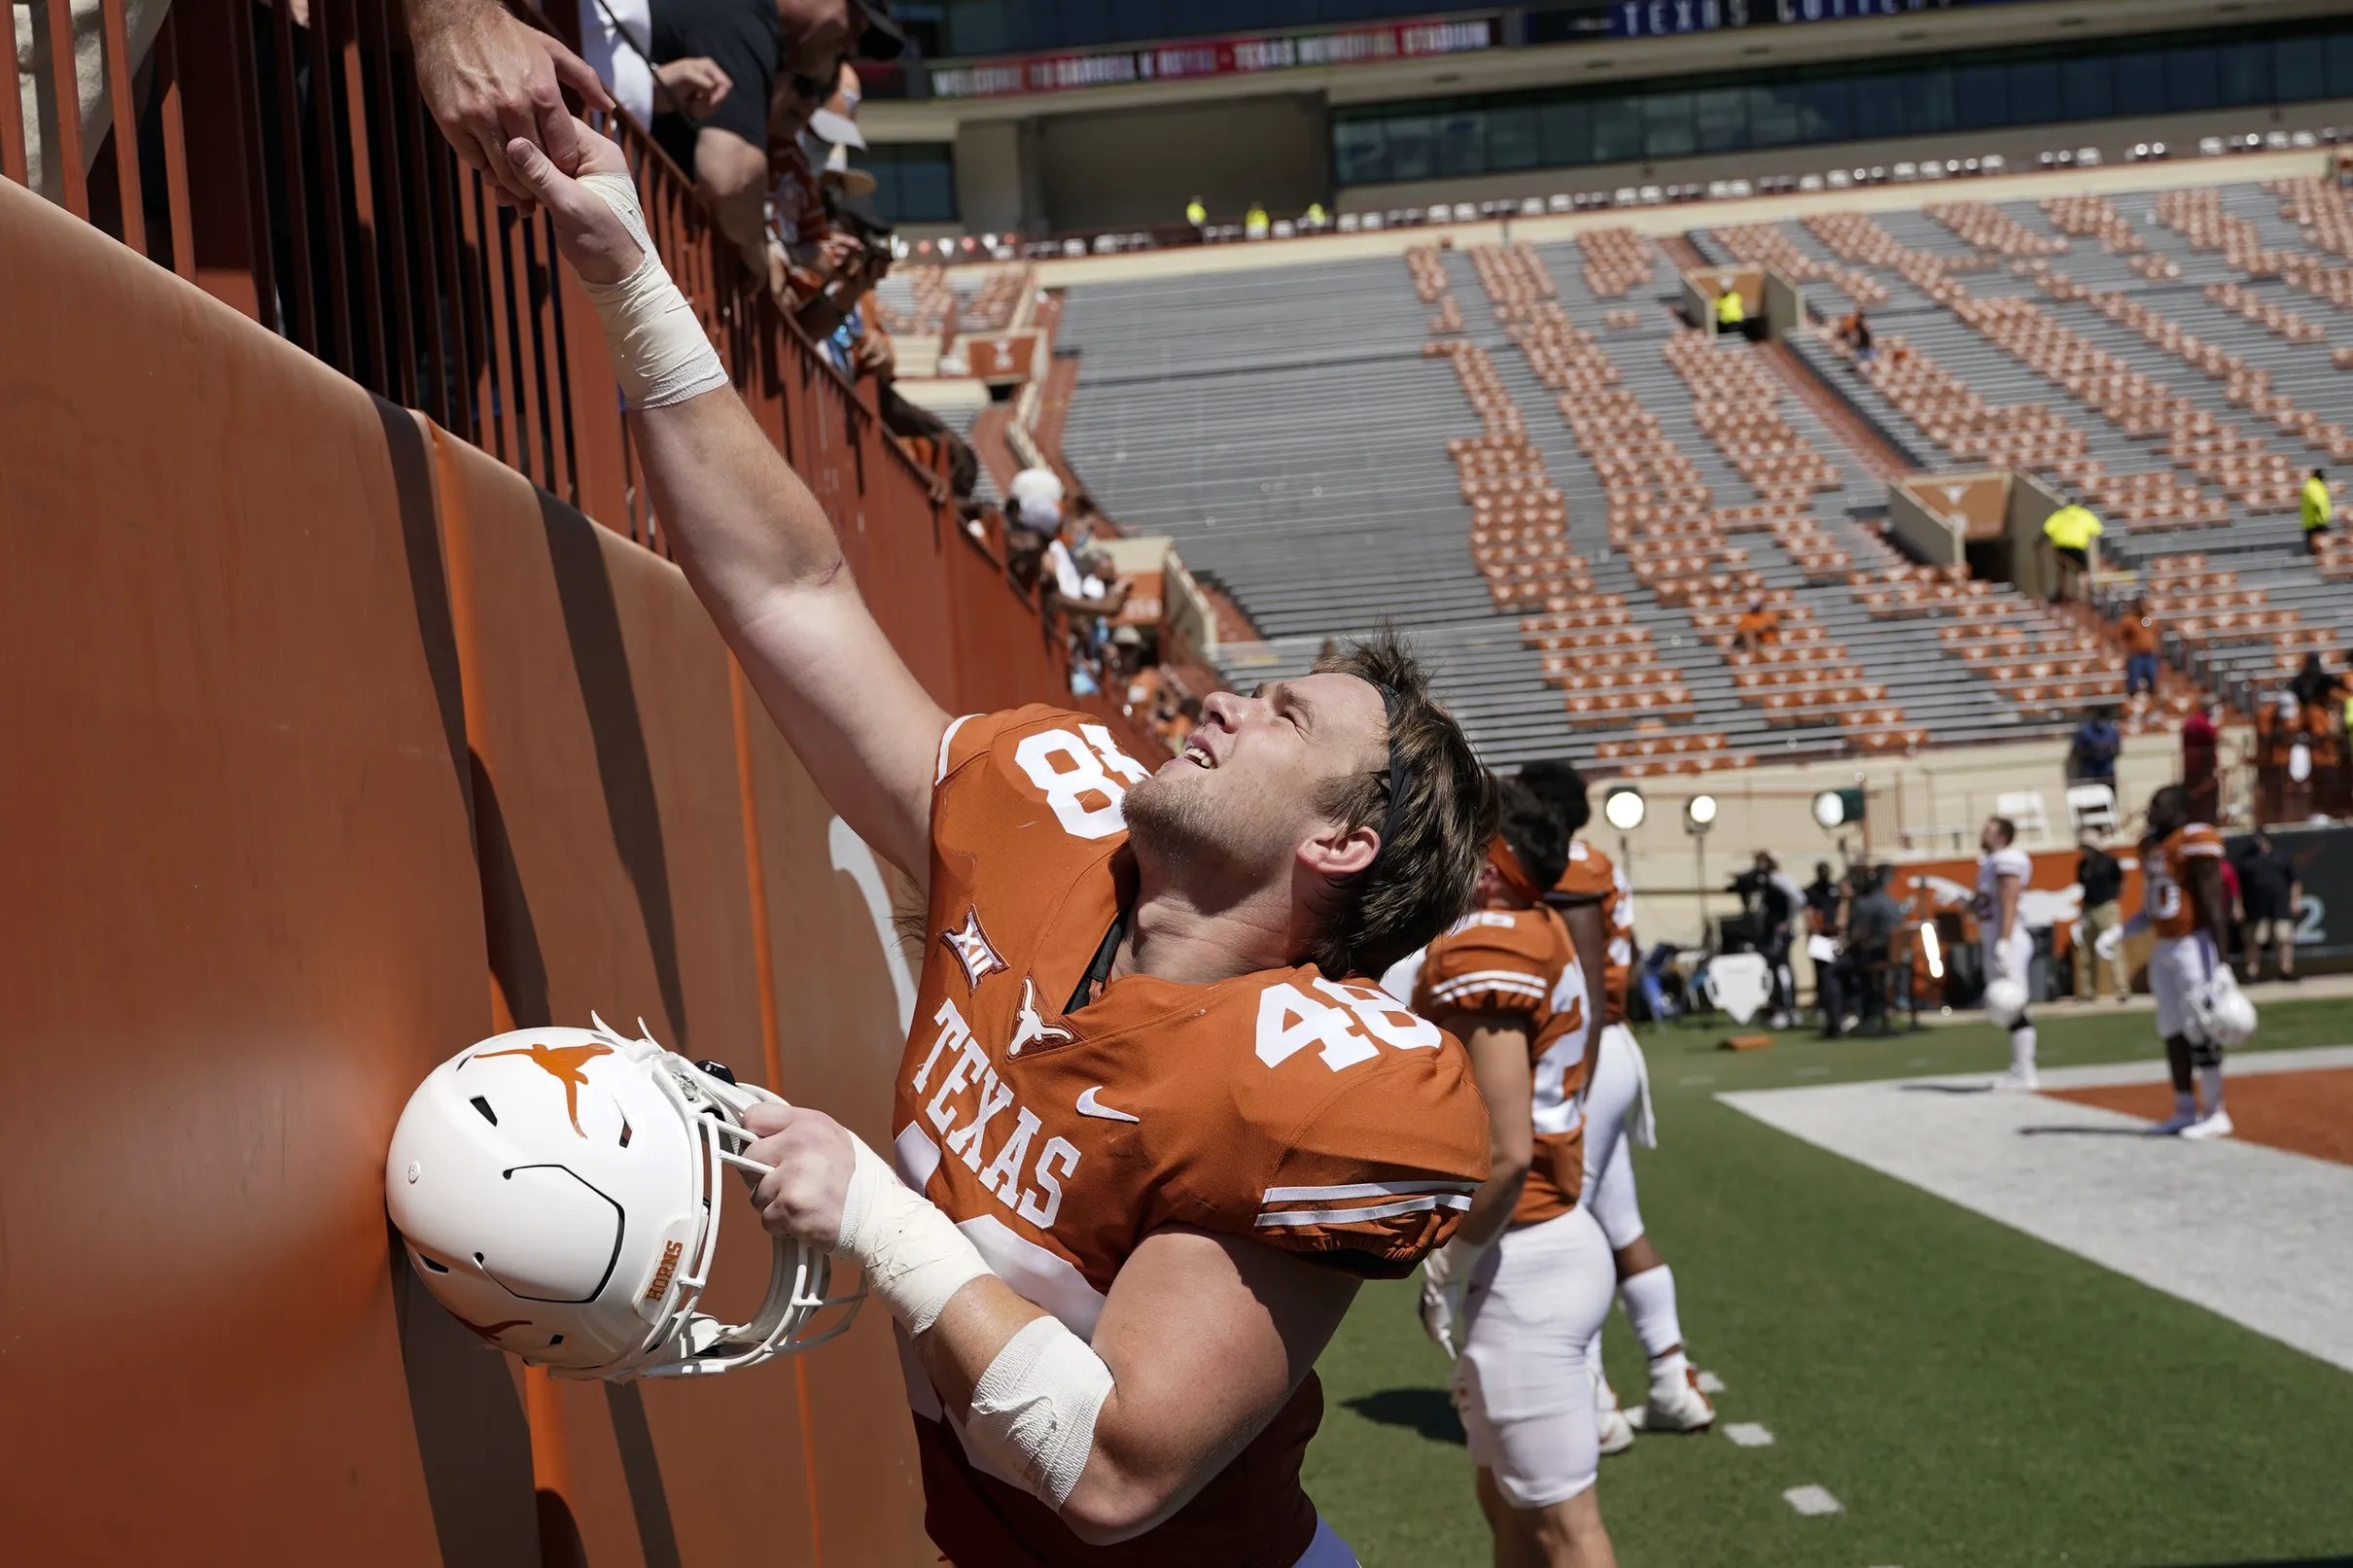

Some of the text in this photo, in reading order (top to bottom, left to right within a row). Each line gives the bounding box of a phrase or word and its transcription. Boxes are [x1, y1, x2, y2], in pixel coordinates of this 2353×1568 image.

[1254, 976, 1443, 1073] 48
[912, 997, 1082, 1230] TEXAS
[645, 1239, 684, 1302] HORNS
